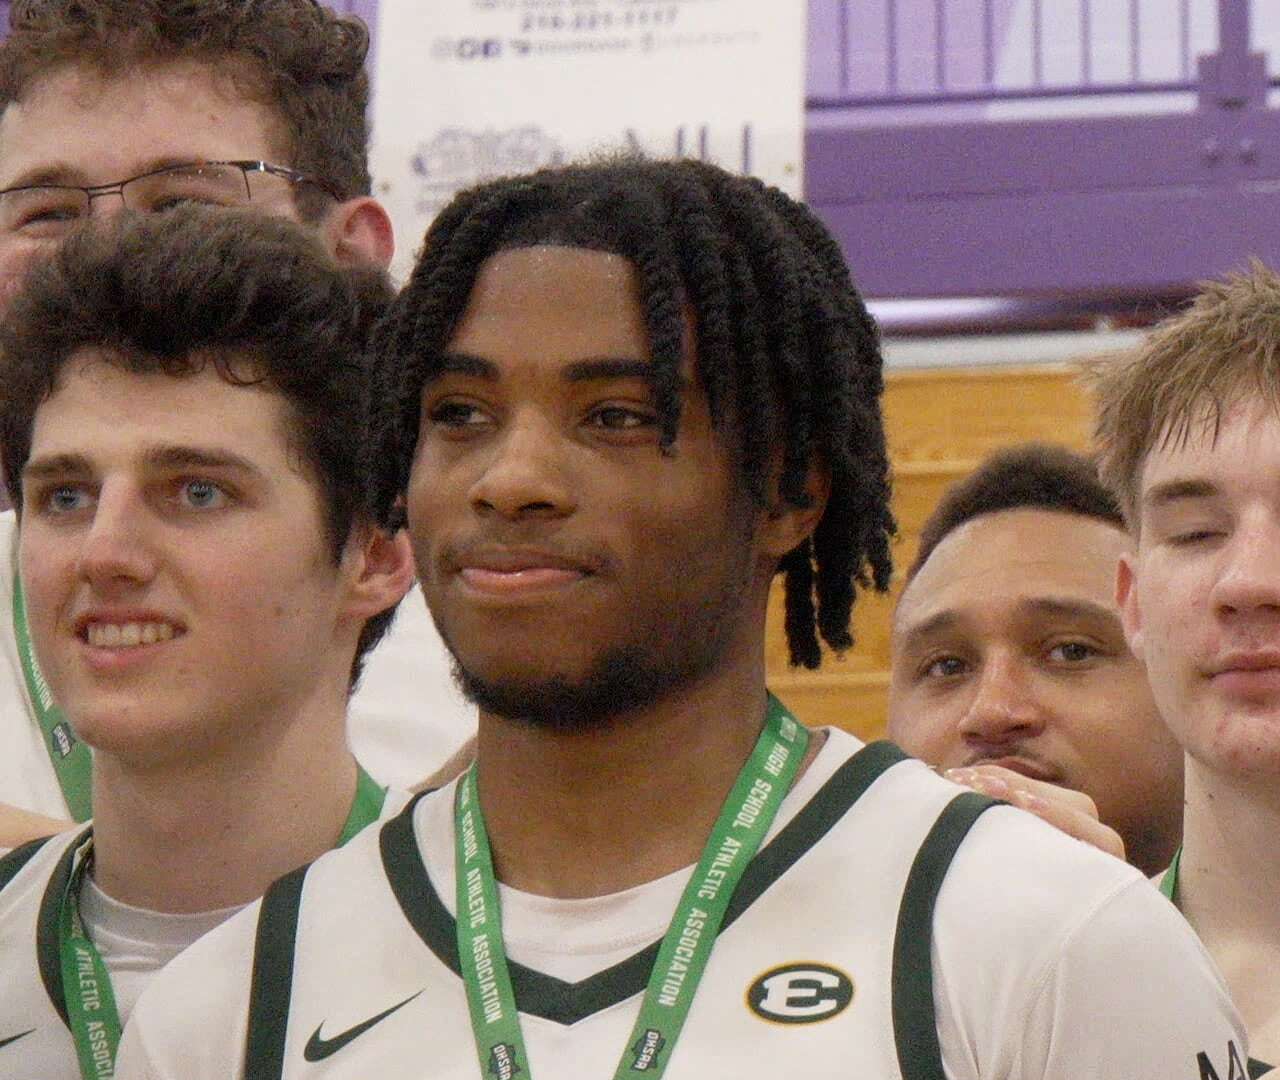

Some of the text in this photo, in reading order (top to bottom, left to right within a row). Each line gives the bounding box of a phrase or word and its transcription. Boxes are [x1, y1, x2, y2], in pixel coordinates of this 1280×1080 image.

[763, 742, 790, 777] HIGH
[732, 778, 773, 829] SCHOOL
[462, 810, 478, 864] SCHOOL
[697, 836, 742, 900] ATHLETIC
[466, 867, 486, 929] ATHLETIC
[75, 948, 100, 1011] ATHLETIC
[472, 934, 504, 1024] ASSOCIATION
[657, 907, 708, 1008] ASSOCIATION
[634, 1030, 660, 1071] OHSAA
